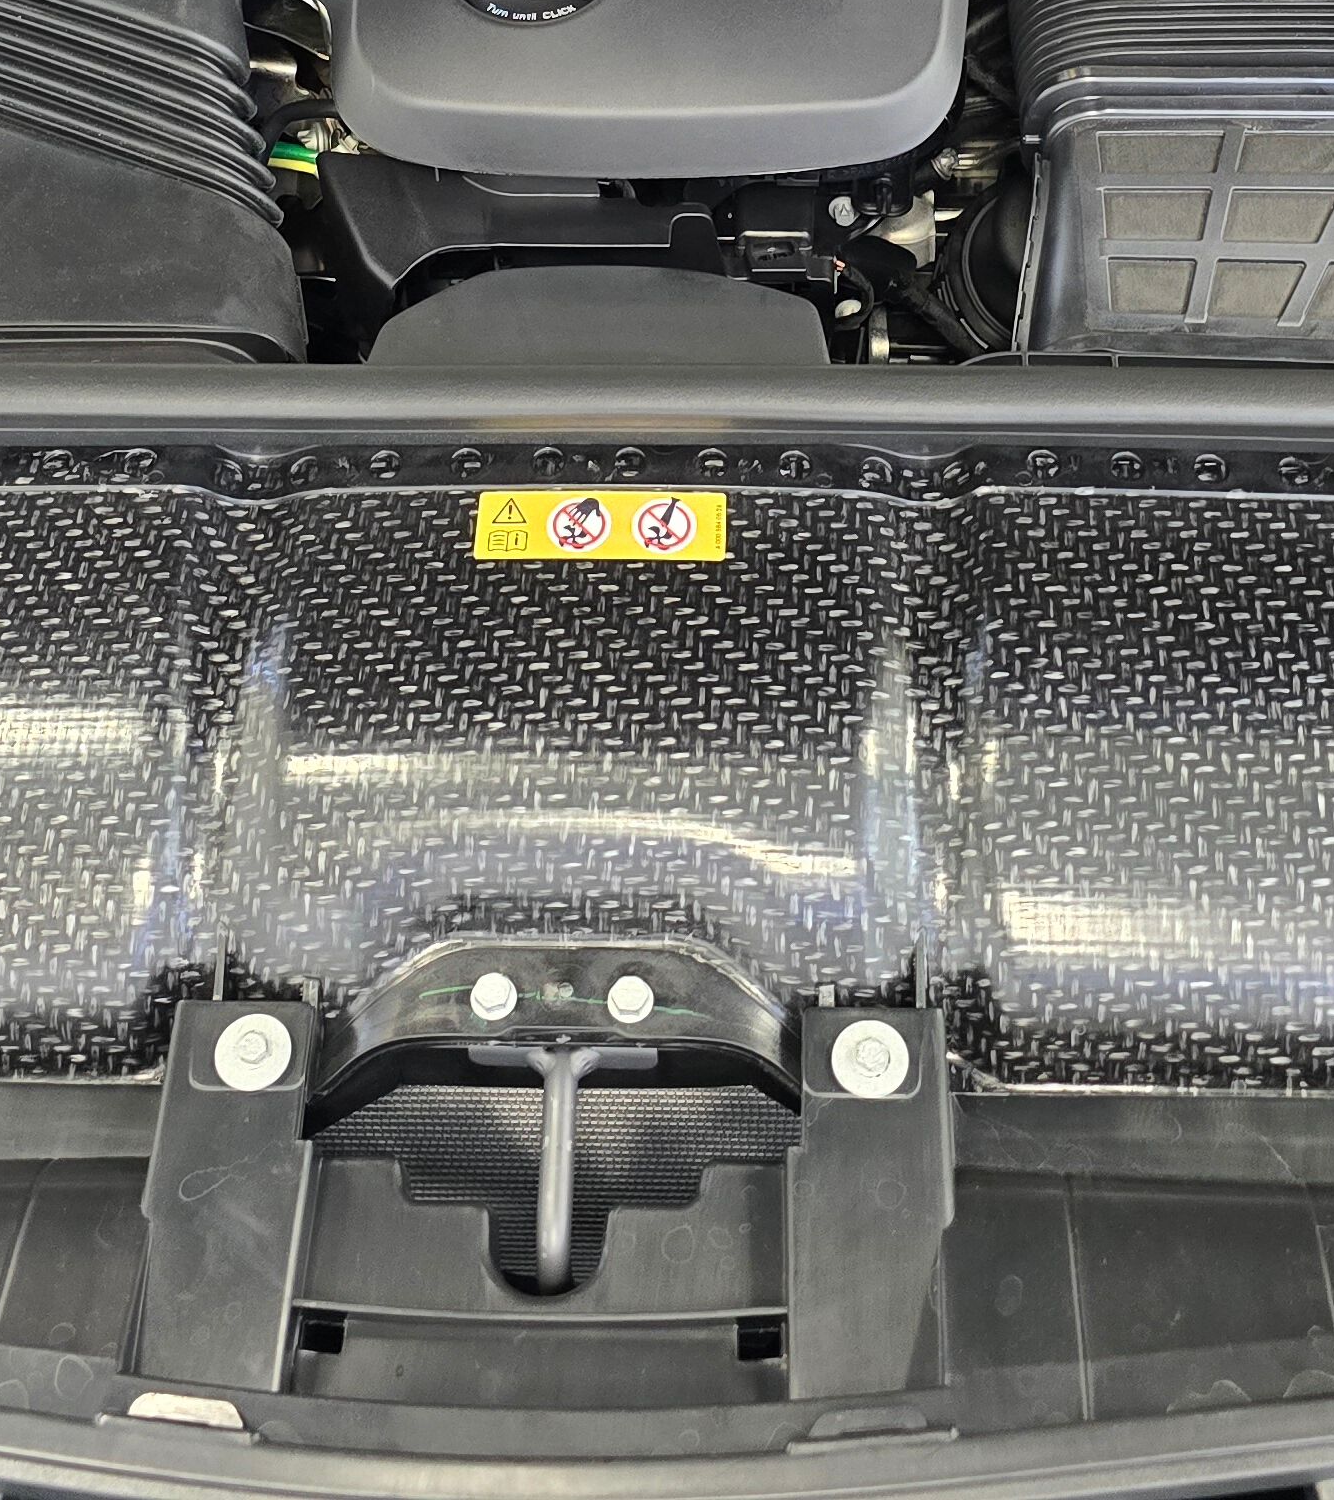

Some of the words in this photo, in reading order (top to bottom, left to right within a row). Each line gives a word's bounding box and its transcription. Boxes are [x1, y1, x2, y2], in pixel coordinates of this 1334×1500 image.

[487, 2, 509, 17] Turn
[512, 11, 537, 20] until
[542, 4, 577, 20] CLICK
